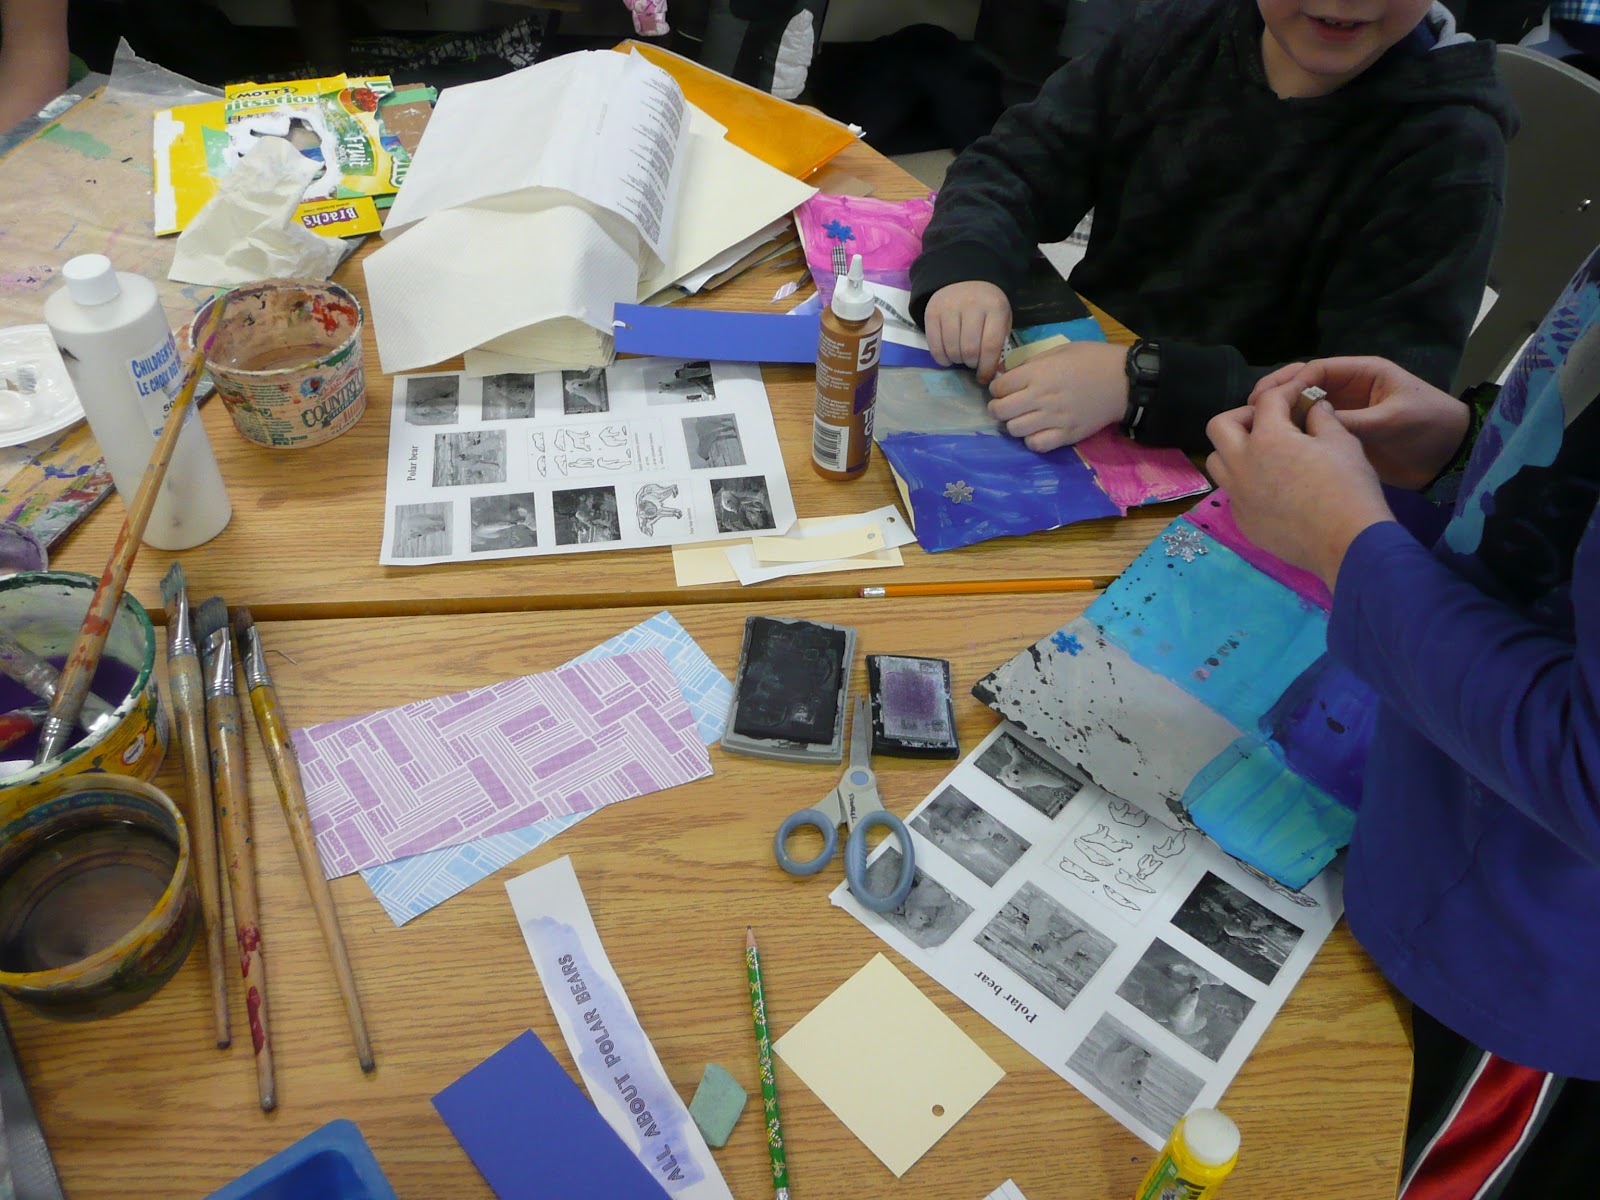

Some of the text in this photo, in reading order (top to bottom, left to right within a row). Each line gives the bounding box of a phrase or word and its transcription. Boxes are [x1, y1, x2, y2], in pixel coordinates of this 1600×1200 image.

[302, 206, 357, 227] Brach's
[859, 338, 878, 365] 5
[136, 380, 150, 397] LE
[406, 444, 419, 481] Polar bear
[974, 971, 1038, 1024] Polar bear
[558, 953, 685, 1182] ALL ABOUT POLAR BEARS
